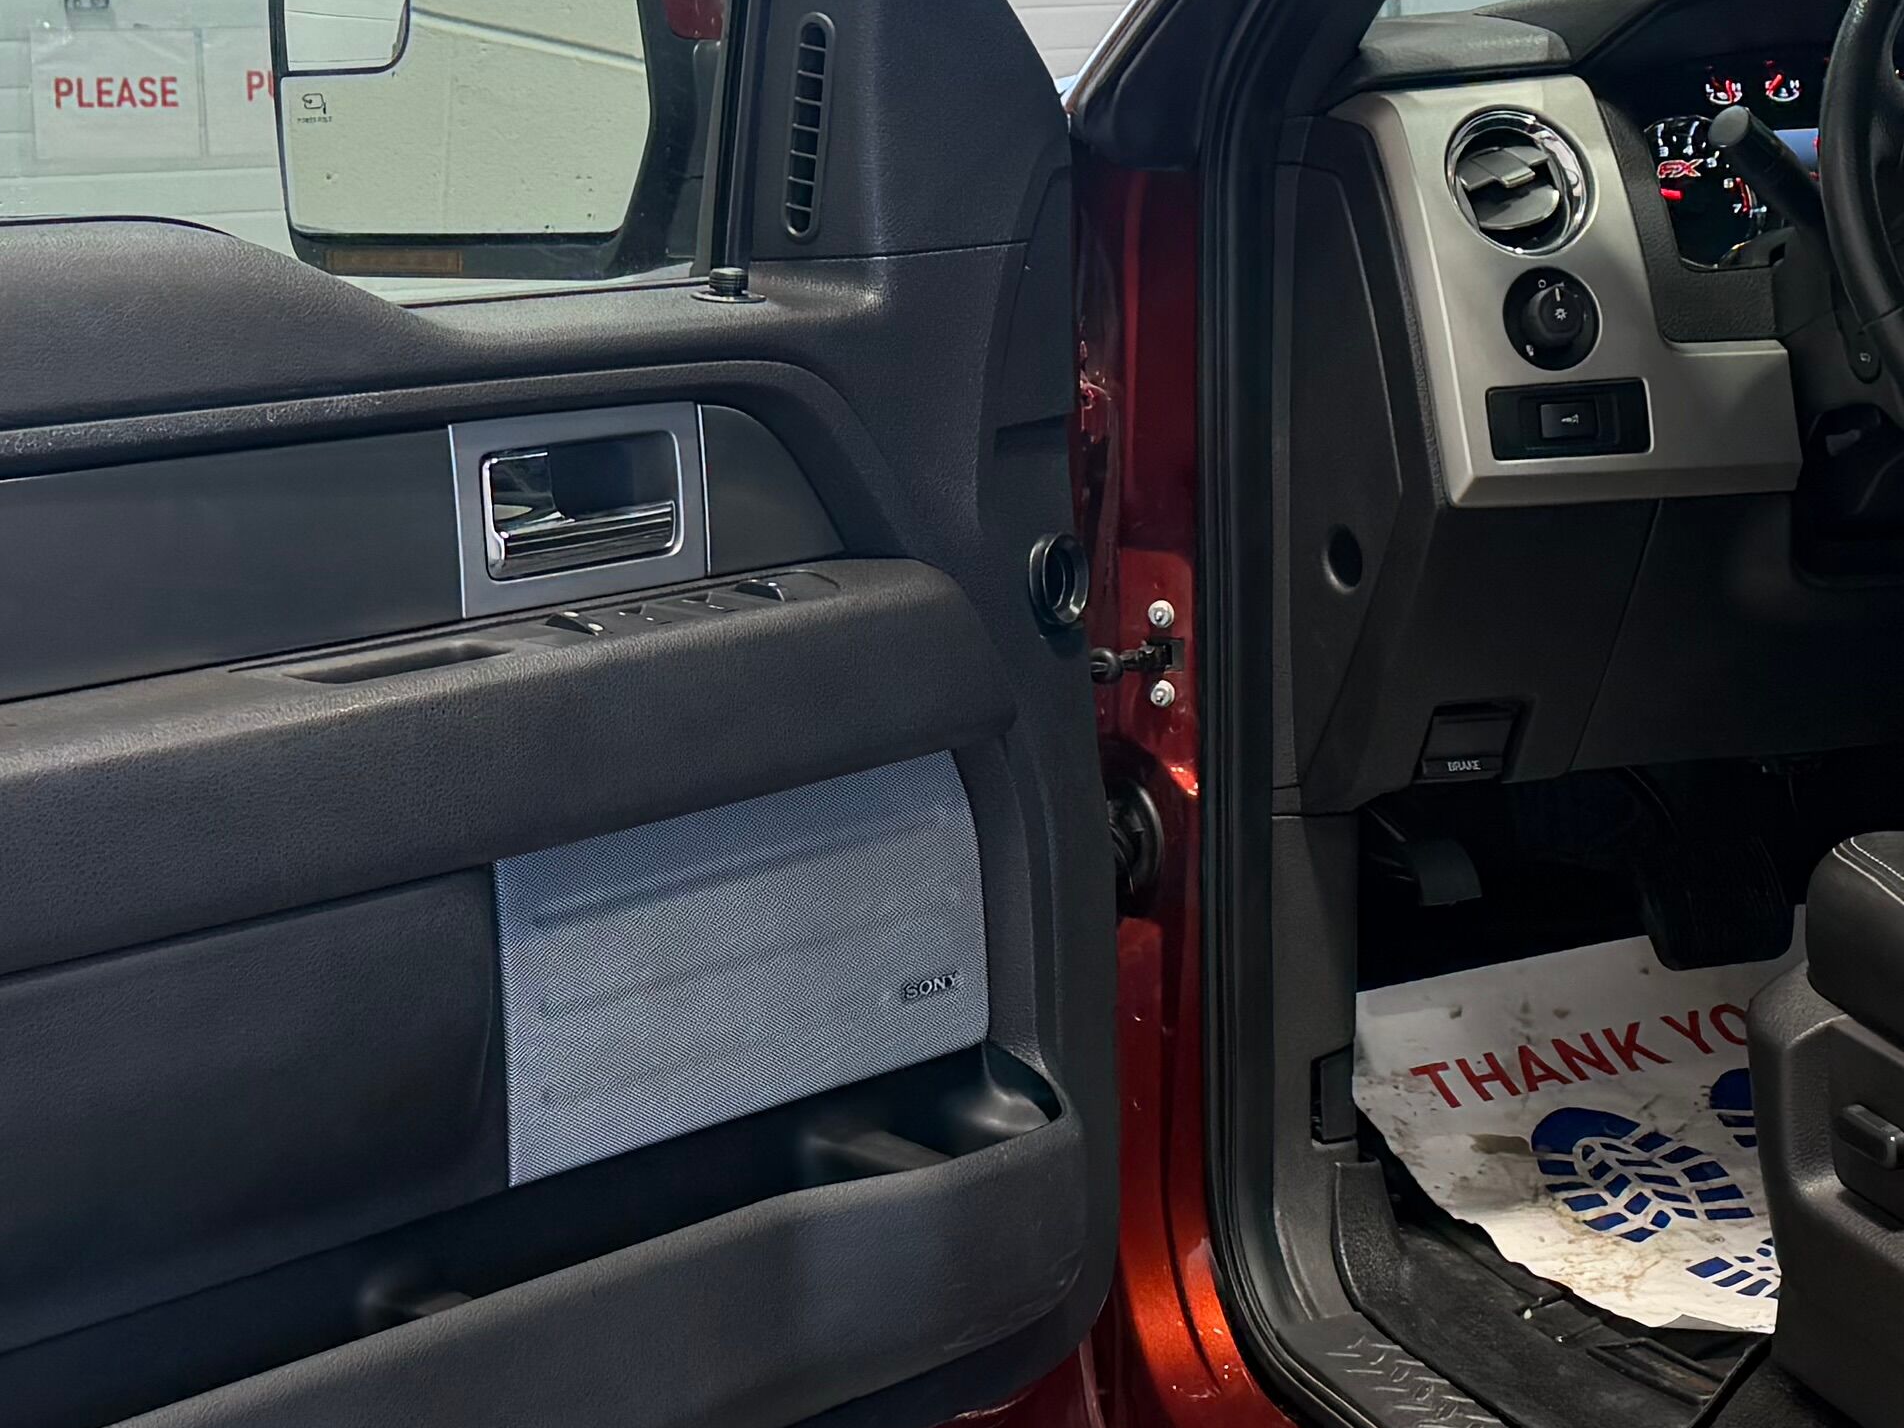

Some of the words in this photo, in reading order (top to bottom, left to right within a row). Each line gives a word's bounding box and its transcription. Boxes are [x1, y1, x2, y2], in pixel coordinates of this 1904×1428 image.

[54, 76, 179, 108] PLEASE
[903, 971, 958, 999] SONY
[1409, 1021, 1673, 1109] THANK
